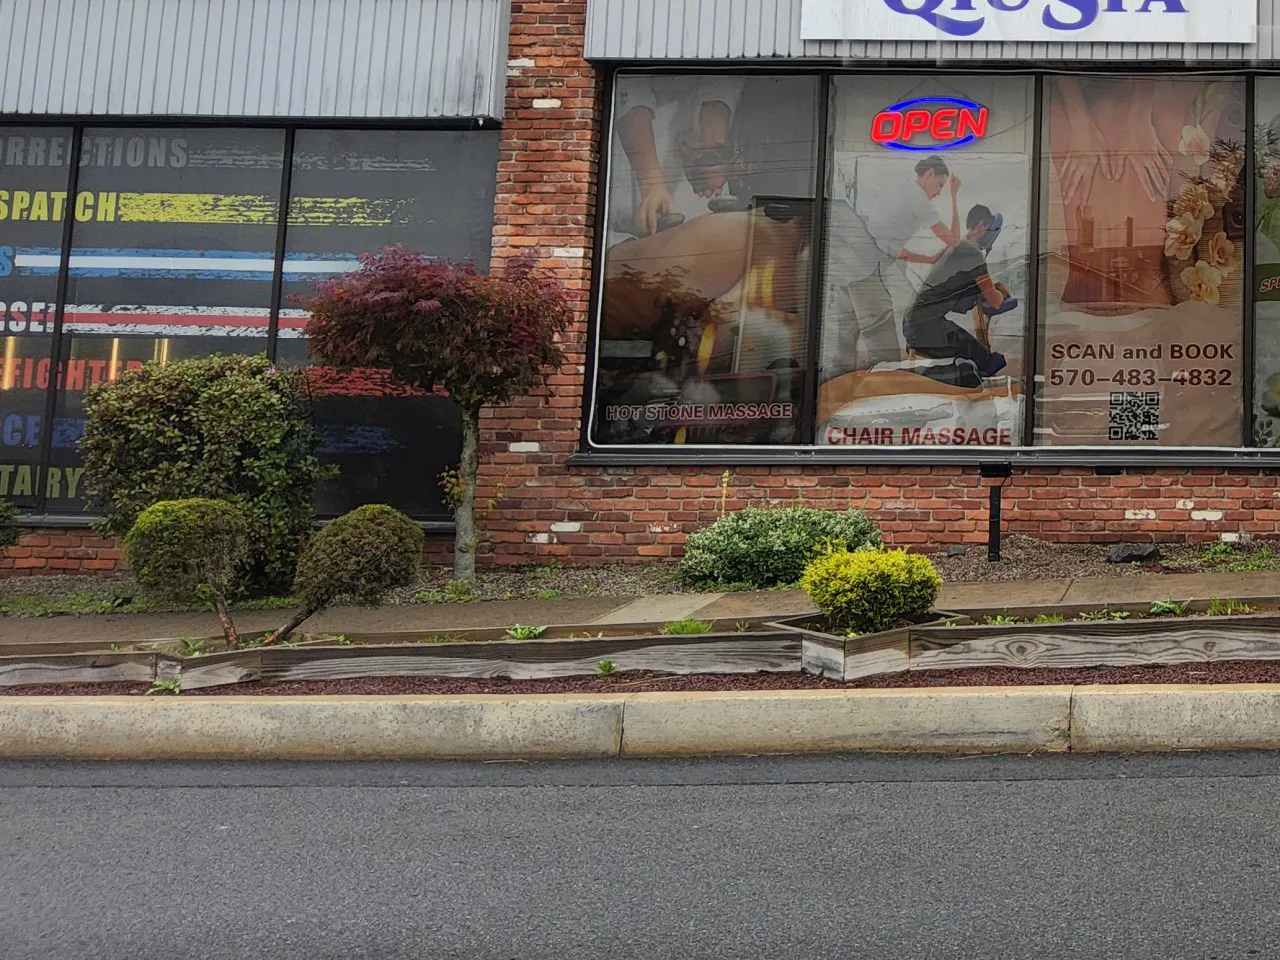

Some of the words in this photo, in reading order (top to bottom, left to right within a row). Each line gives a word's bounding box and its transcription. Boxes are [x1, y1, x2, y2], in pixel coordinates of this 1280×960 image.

[870, 107, 988, 143] OPEN
[0, 136, 189, 168] RRECTIONS
[1051, 343, 1115, 360] SCAN
[1122, 344, 1162, 360] and
[1170, 343, 1234, 360] BOOK
[606, 405, 642, 421] HOT
[645, 403, 704, 420] STONE
[708, 402, 794, 420] MASSAGE
[827, 427, 895, 446] CHAIR
[901, 427, 1013, 446] MASSAGE
